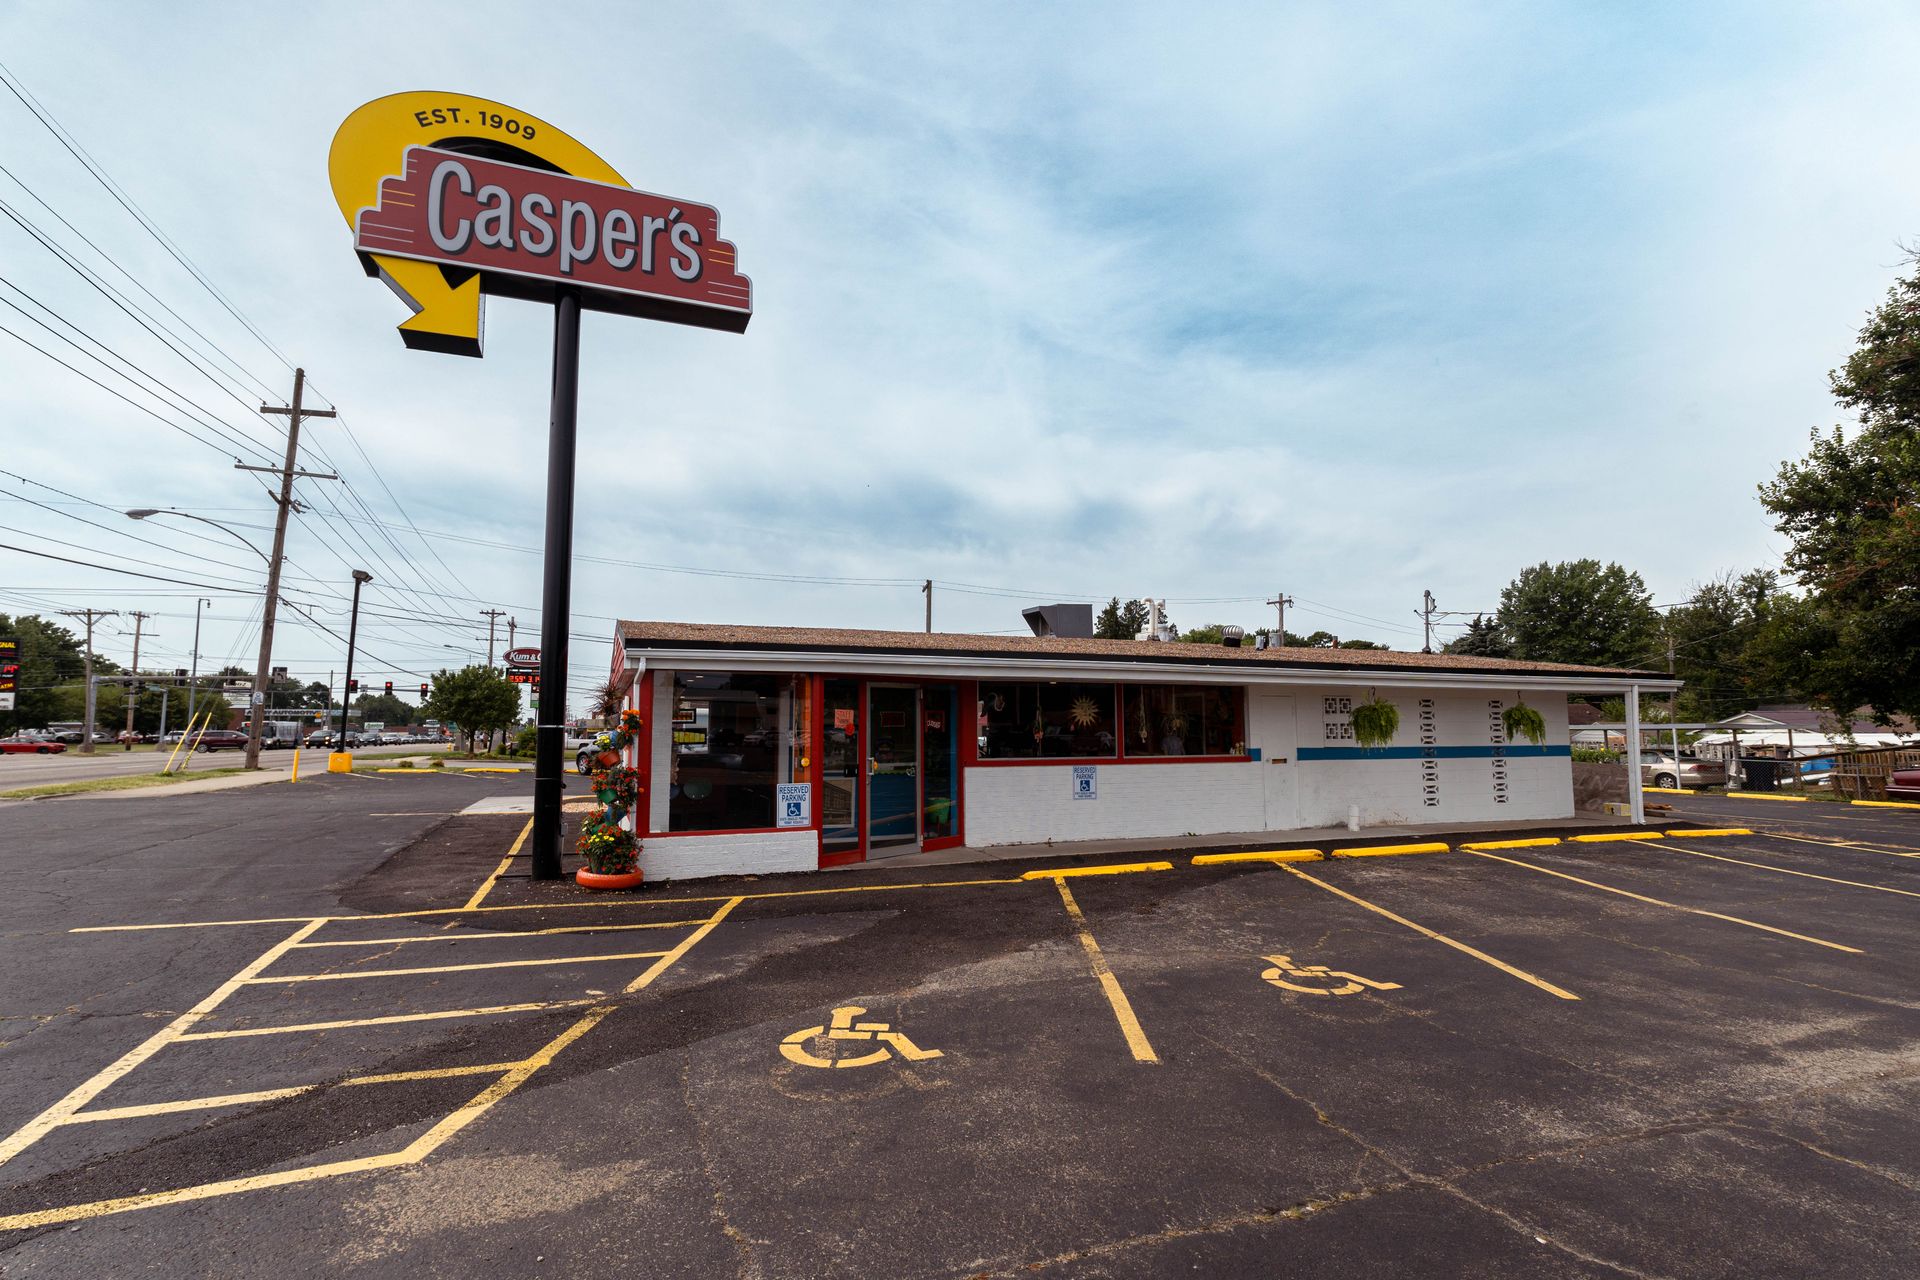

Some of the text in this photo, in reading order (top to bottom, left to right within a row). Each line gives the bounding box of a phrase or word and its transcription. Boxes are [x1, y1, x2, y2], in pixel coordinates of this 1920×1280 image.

[414, 108, 536, 140] EST. 1909
[427, 160, 704, 282] Casper's
[509, 652, 529, 662] Kum
[779, 786, 809, 794] RESERVED
[782, 794, 806, 802] PARKING
